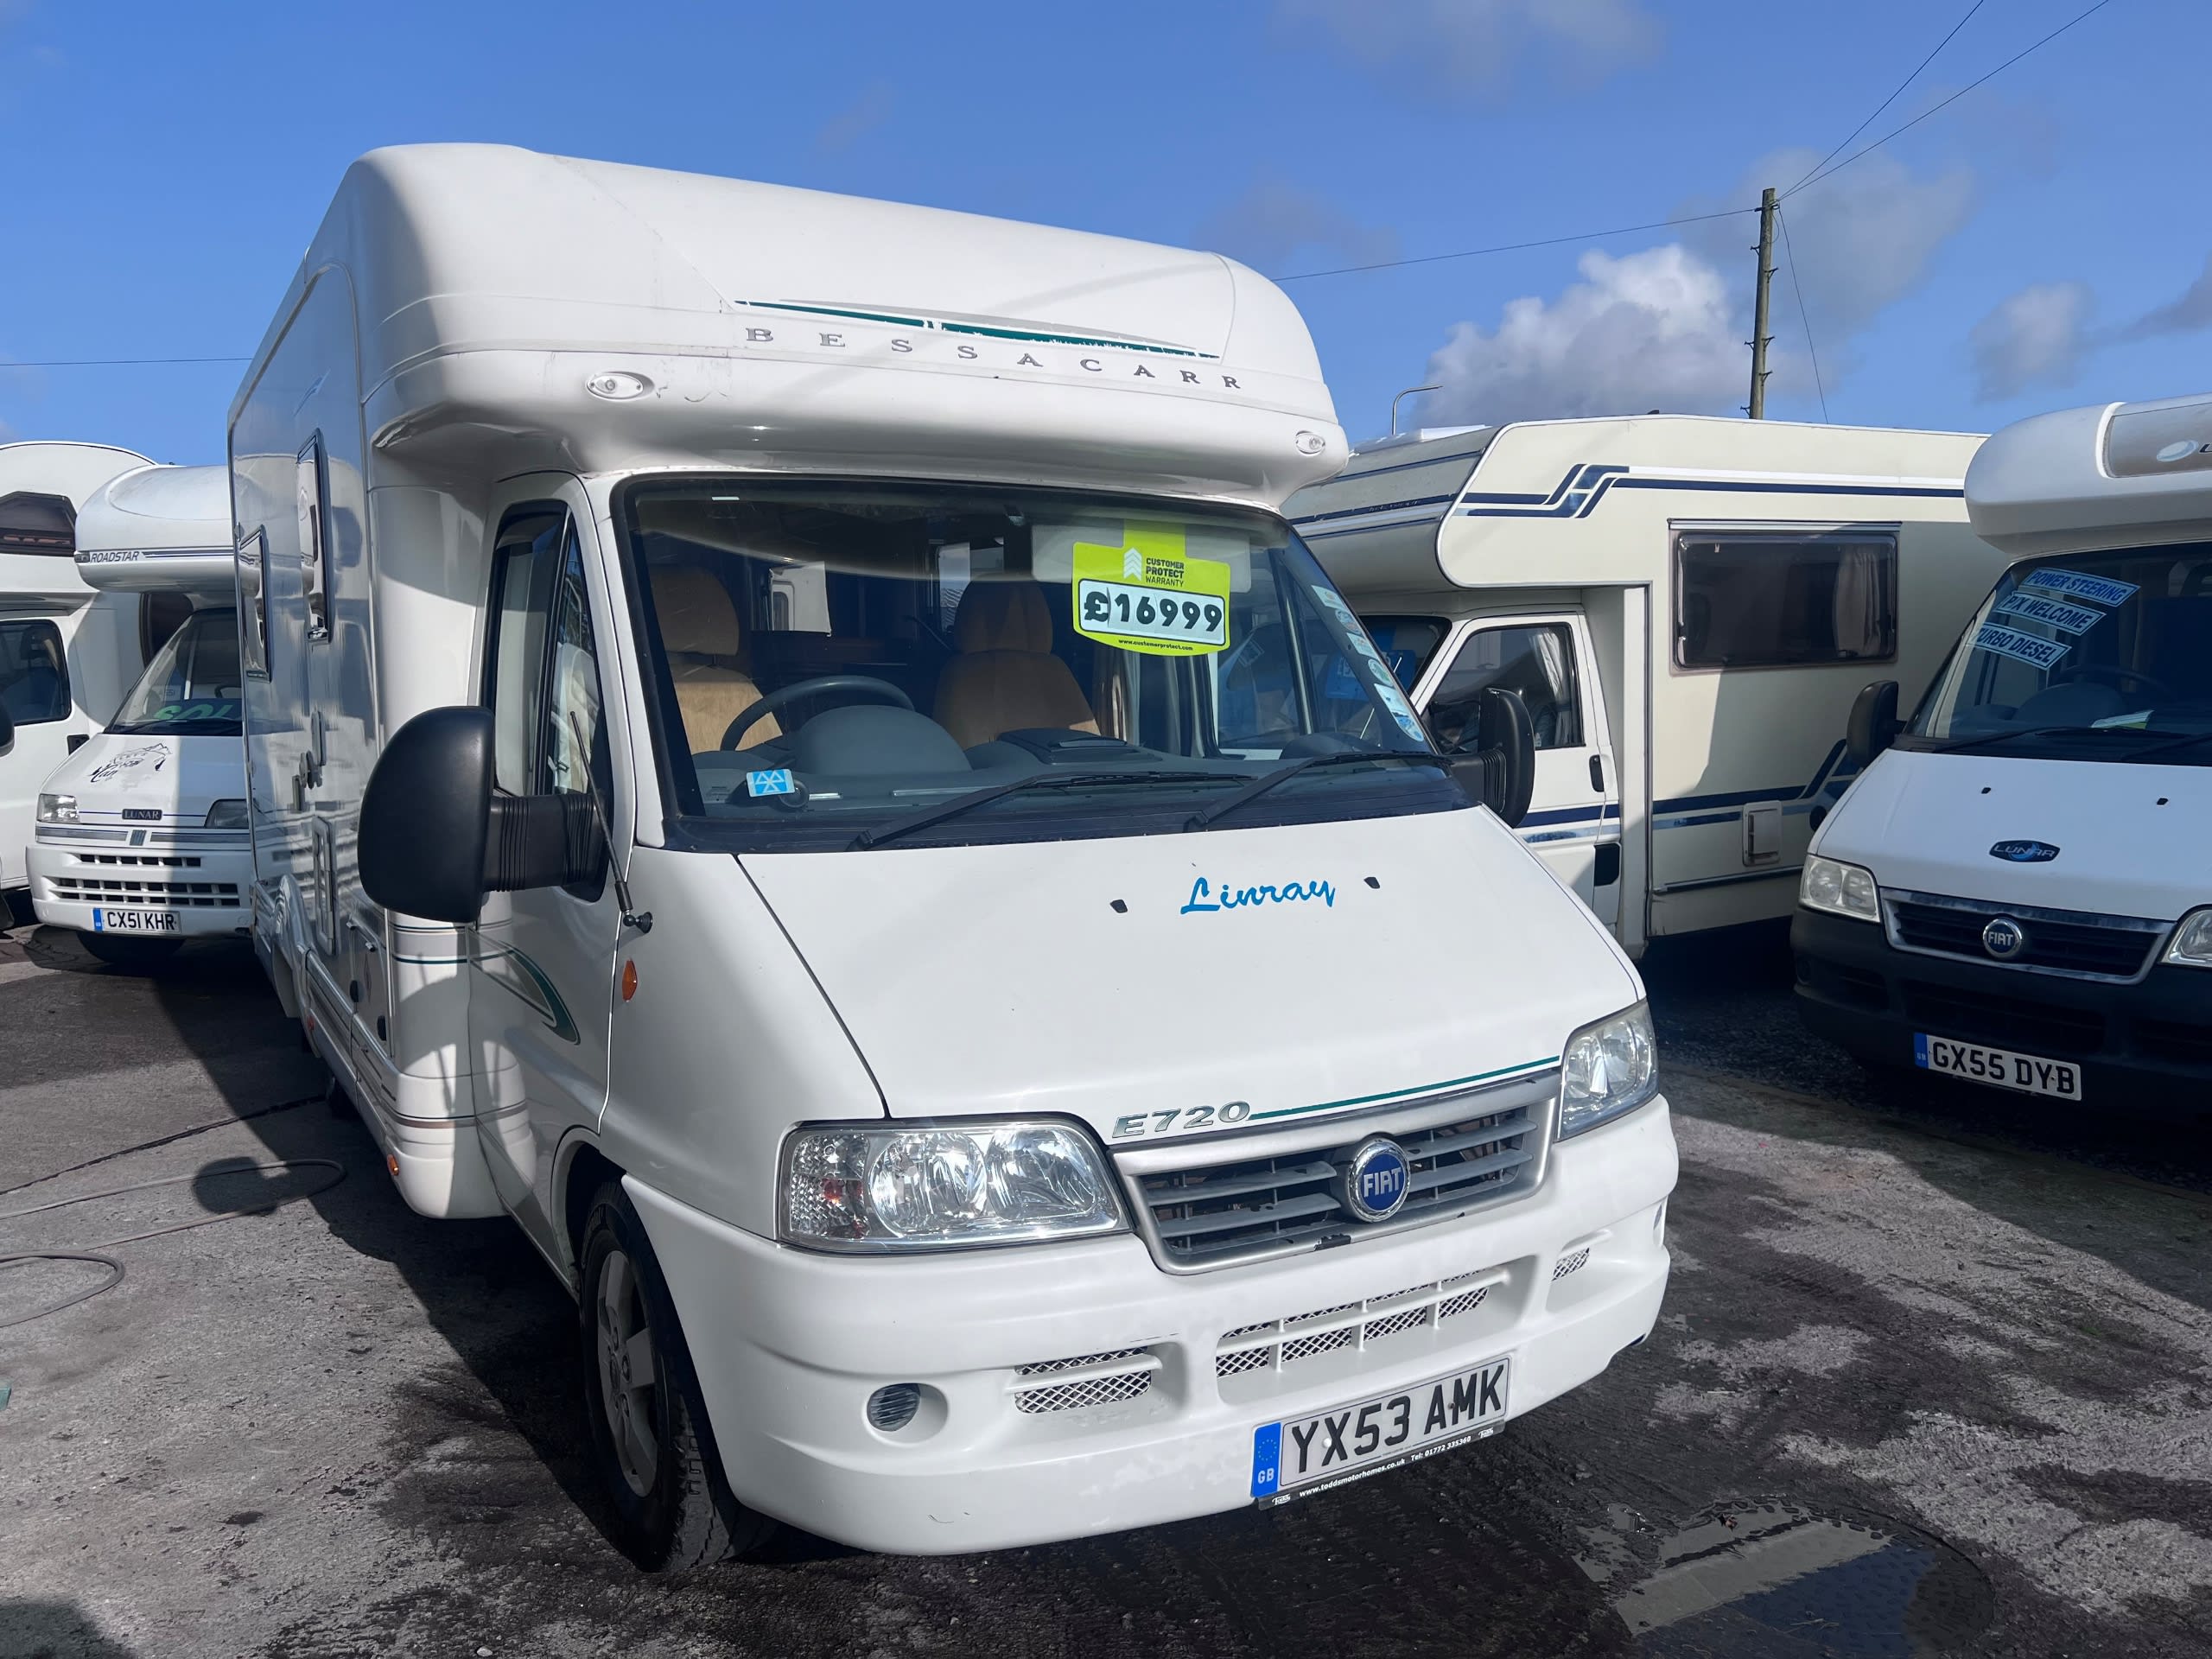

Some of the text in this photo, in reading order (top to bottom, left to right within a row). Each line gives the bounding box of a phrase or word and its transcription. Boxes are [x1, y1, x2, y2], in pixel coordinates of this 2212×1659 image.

[746, 327, 1241, 390] BESSACARR
[90, 550, 140, 562] ROADSTAR
[1146, 557, 1185, 569] CUSTOMER
[1145, 575, 1185, 588] WARRANTY
[1146, 566, 1185, 579] PROTECT
[2028, 571, 2127, 601] POWER STEERING
[1084, 591, 1223, 632] £16999
[2024, 599, 2093, 628] WELCOME
[1118, 639, 1193, 651] www.customerprotect.com
[1977, 627, 2056, 663] TURBO DIESEL
[124, 809, 160, 820] LUNAR
[1993, 843, 2056, 858] LUNAR
[107, 912, 175, 931] CX51 KHR
[1987, 931, 2014, 947] FIAT
[1932, 1041, 2005, 1081] GX55
[2014, 1058, 2075, 1095] DYB
[1112, 1100, 1250, 1139] E720
[1363, 1166, 1402, 1198] FIAT
[1292, 1364, 1504, 1473] YX53 AMK
[1257, 1467, 1274, 1485] GB
[1299, 1458, 1406, 1498] www.toddsmotorhomes.co.uk
[1410, 1452, 1424, 1462] Tel:
[1424, 1444, 1446, 1458] 01772
[1446, 1435, 1471, 1450] 335360
